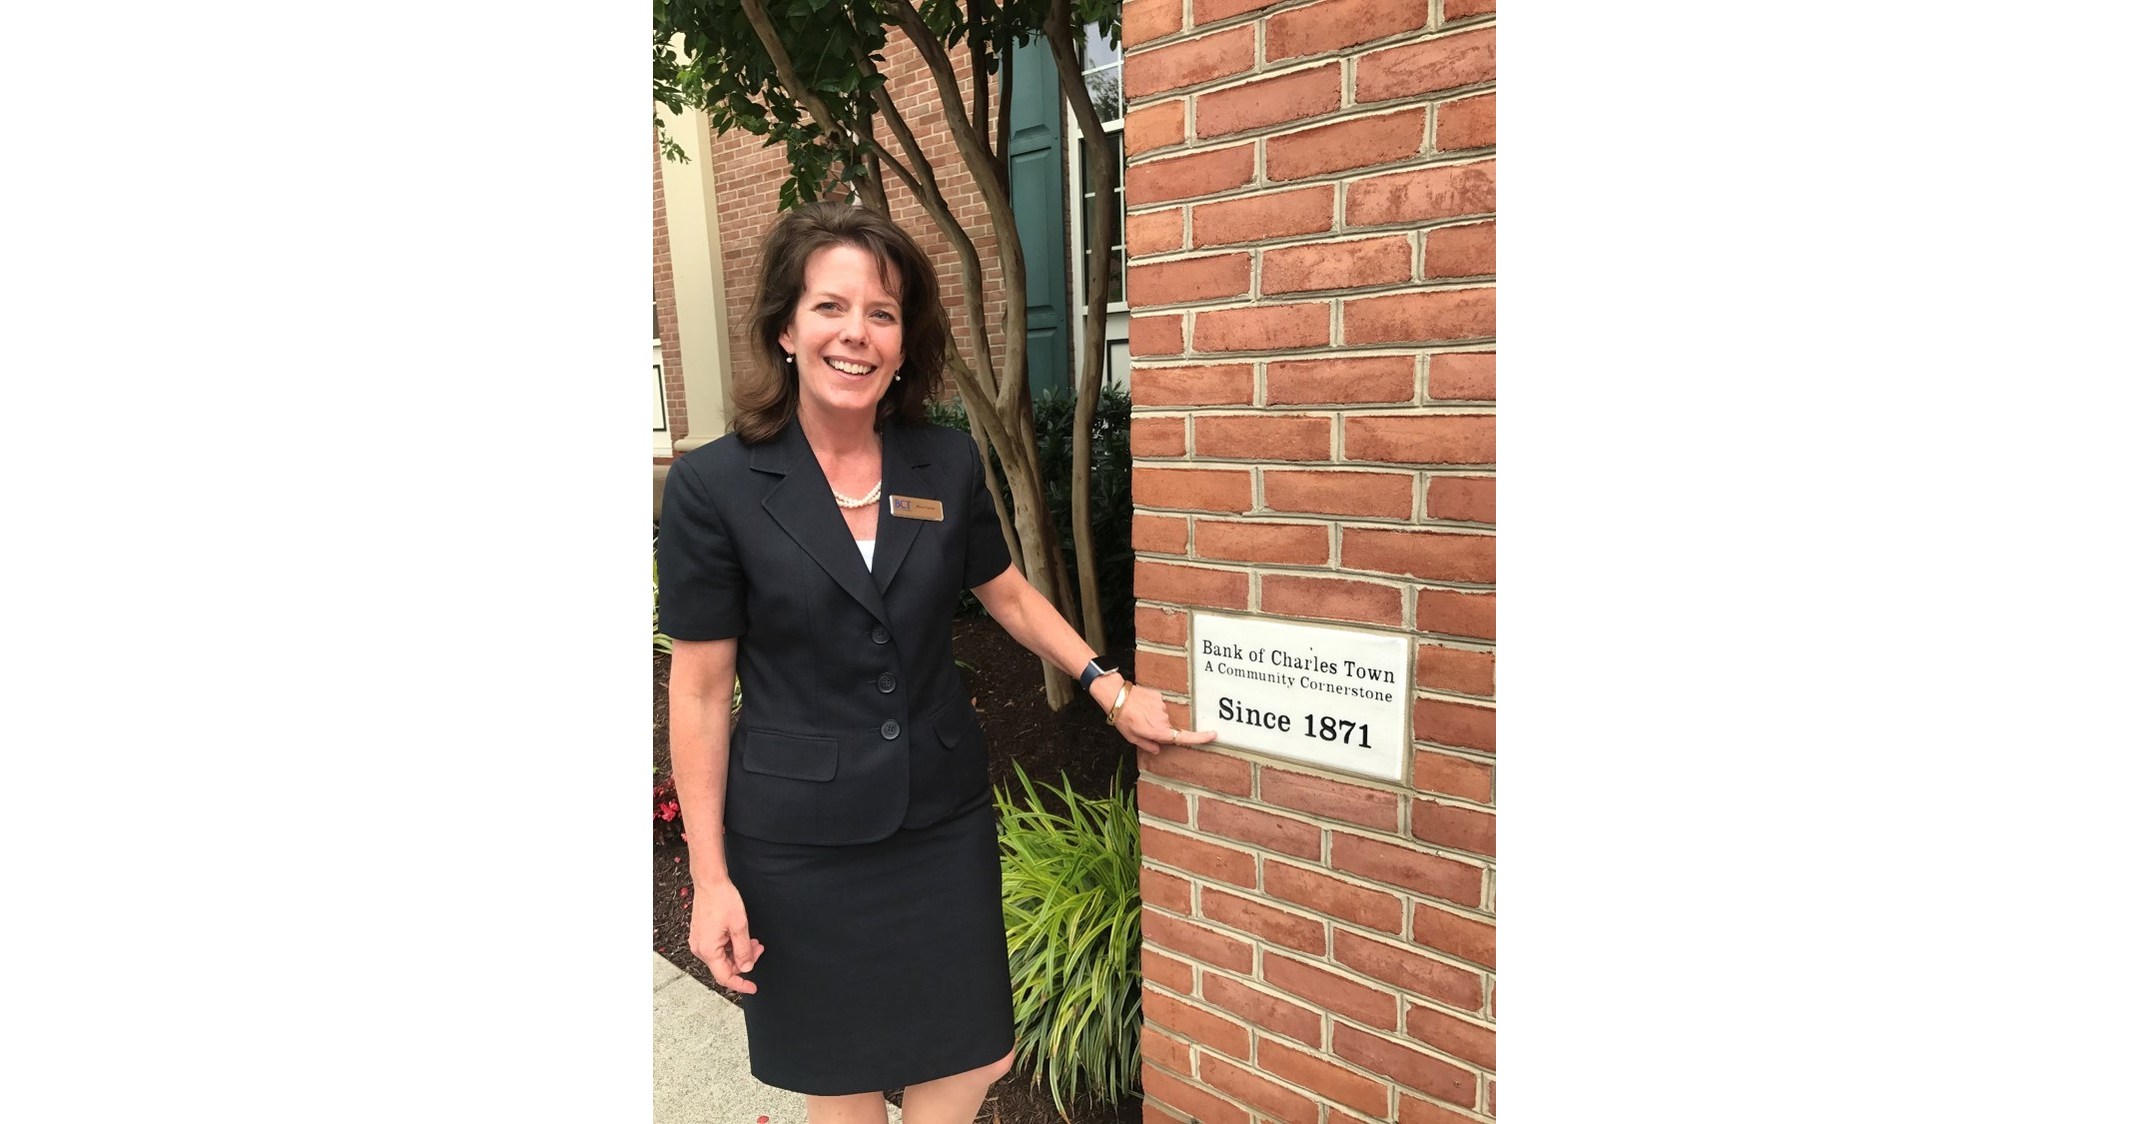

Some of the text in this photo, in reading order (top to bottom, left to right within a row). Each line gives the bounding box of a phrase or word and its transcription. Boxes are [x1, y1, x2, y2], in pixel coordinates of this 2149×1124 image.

[1202, 639, 1396, 684] Bank of Charles Town
[1204, 660, 1394, 703] A Community Cornerstone
[1218, 696, 1373, 749] Since 1871
